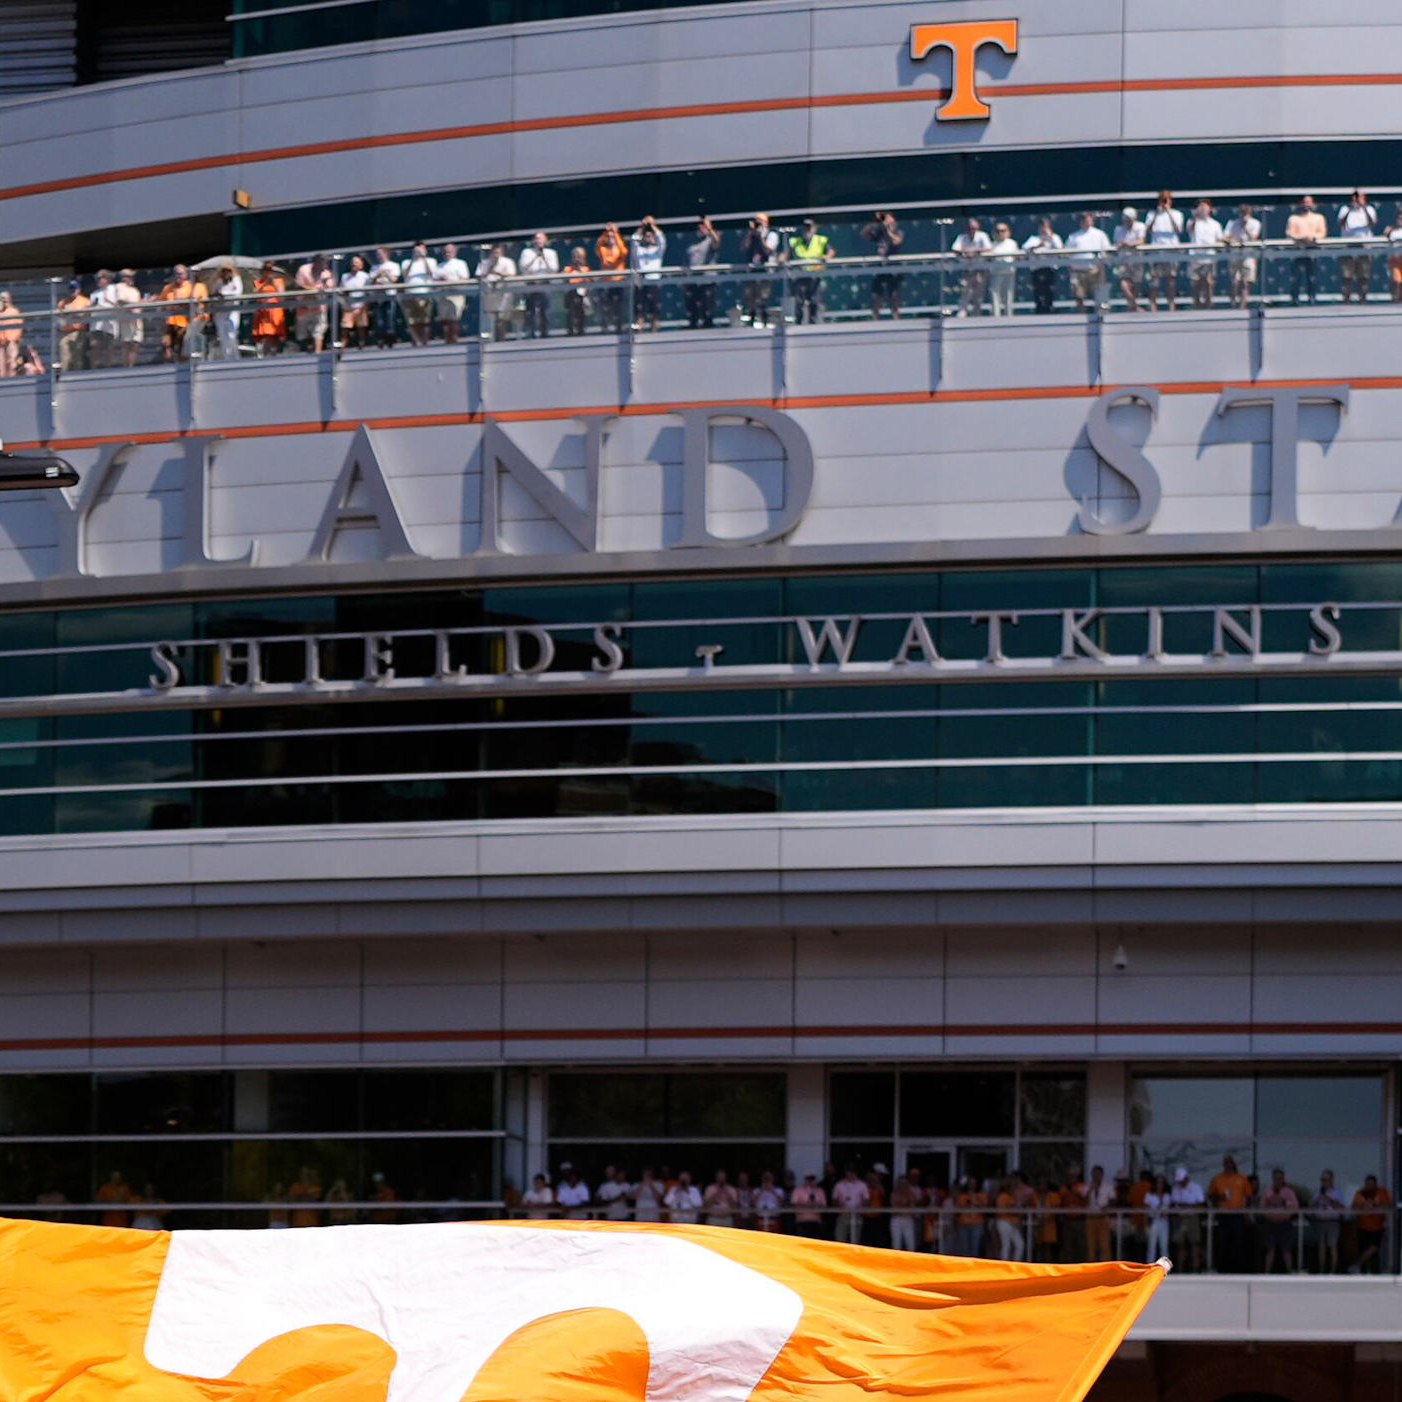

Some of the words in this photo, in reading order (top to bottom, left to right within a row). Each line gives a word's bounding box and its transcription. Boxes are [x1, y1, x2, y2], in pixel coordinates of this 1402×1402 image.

[910, 18, 1019, 122] T
[148, 621, 626, 692] SHIELDS
[796, 605, 1344, 670] WATKINS
